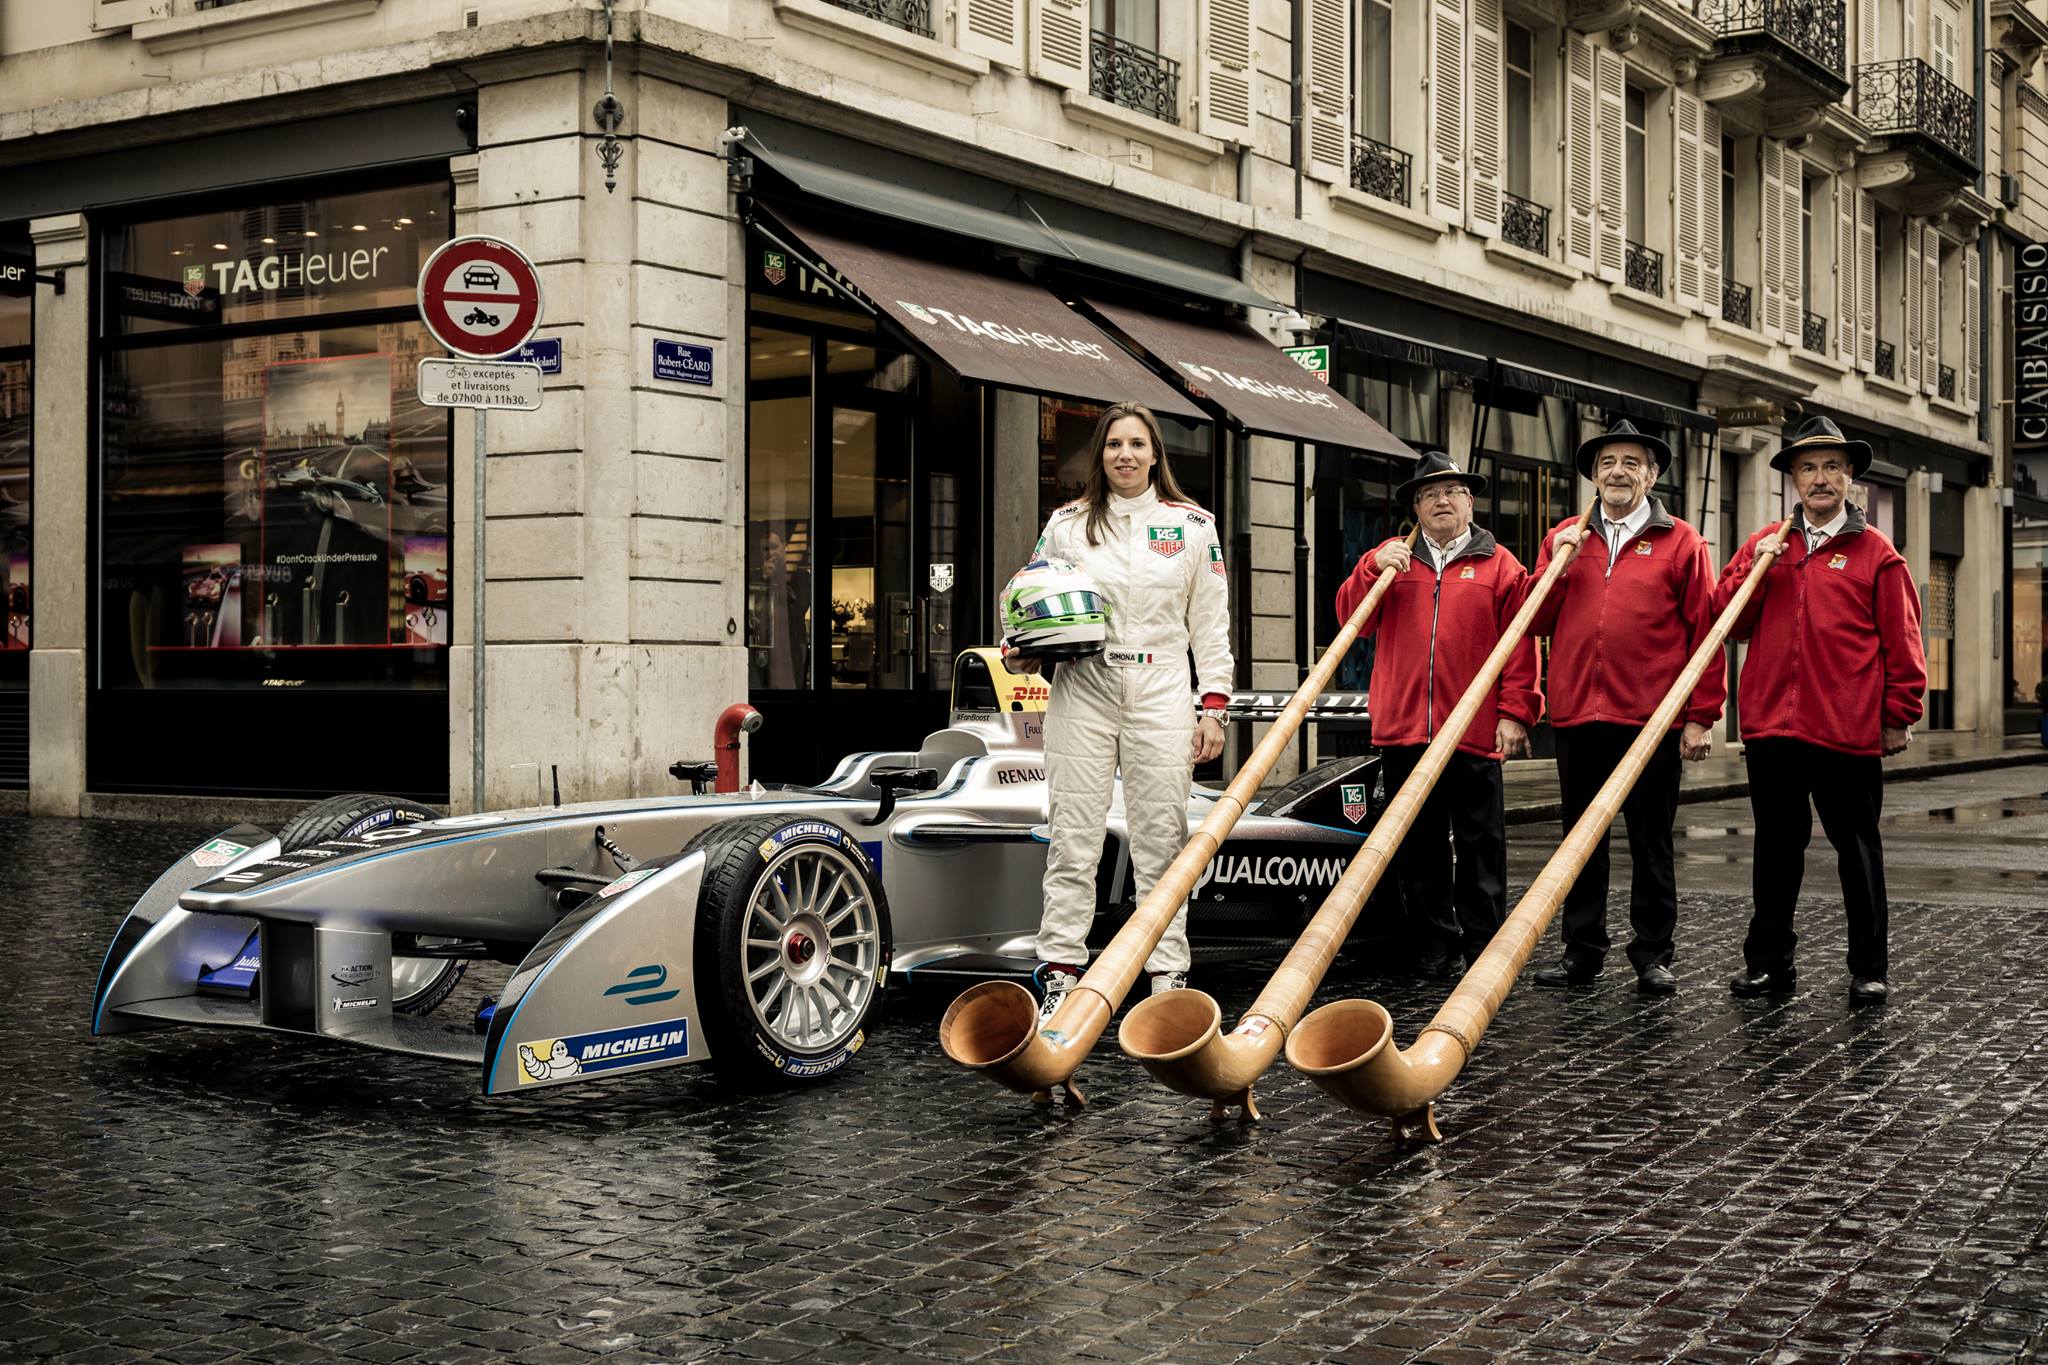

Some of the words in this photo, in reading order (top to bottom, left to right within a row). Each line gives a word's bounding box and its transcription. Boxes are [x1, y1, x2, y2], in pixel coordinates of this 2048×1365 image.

[767, 254, 783, 268] TAG
[2020, 243, 2048, 440] CABASSO
[520, 346, 535, 356] Rue
[677, 346, 691, 358] Rue
[472, 368, 515, 380] exceptés
[451, 382, 461, 391] et
[464, 381, 510, 392] livraisons
[437, 392, 449, 402] de
[452, 393, 483, 403] 07h00
[485, 394, 491, 403] à
[1058, 506, 1078, 515] OMP
[1187, 512, 1207, 526] OMP
[1153, 528, 1179, 540] TAG
[1152, 541, 1182, 556] HEUER
[276, 552, 378, 565] #DontCrackUnderPressure
[1109, 652, 1136, 661] SIMONA
[956, 714, 990, 722] #FanBoost
[997, 768, 1046, 784] RENAU
[1346, 787, 1362, 802] TAG
[780, 824, 839, 841] MICHELIN
[351, 964, 373, 972] ACTION
[342, 999, 377, 1008] MICHELIN
[581, 1030, 684, 1060] MICHELIN
[788, 1053, 847, 1075] MICHELIN
